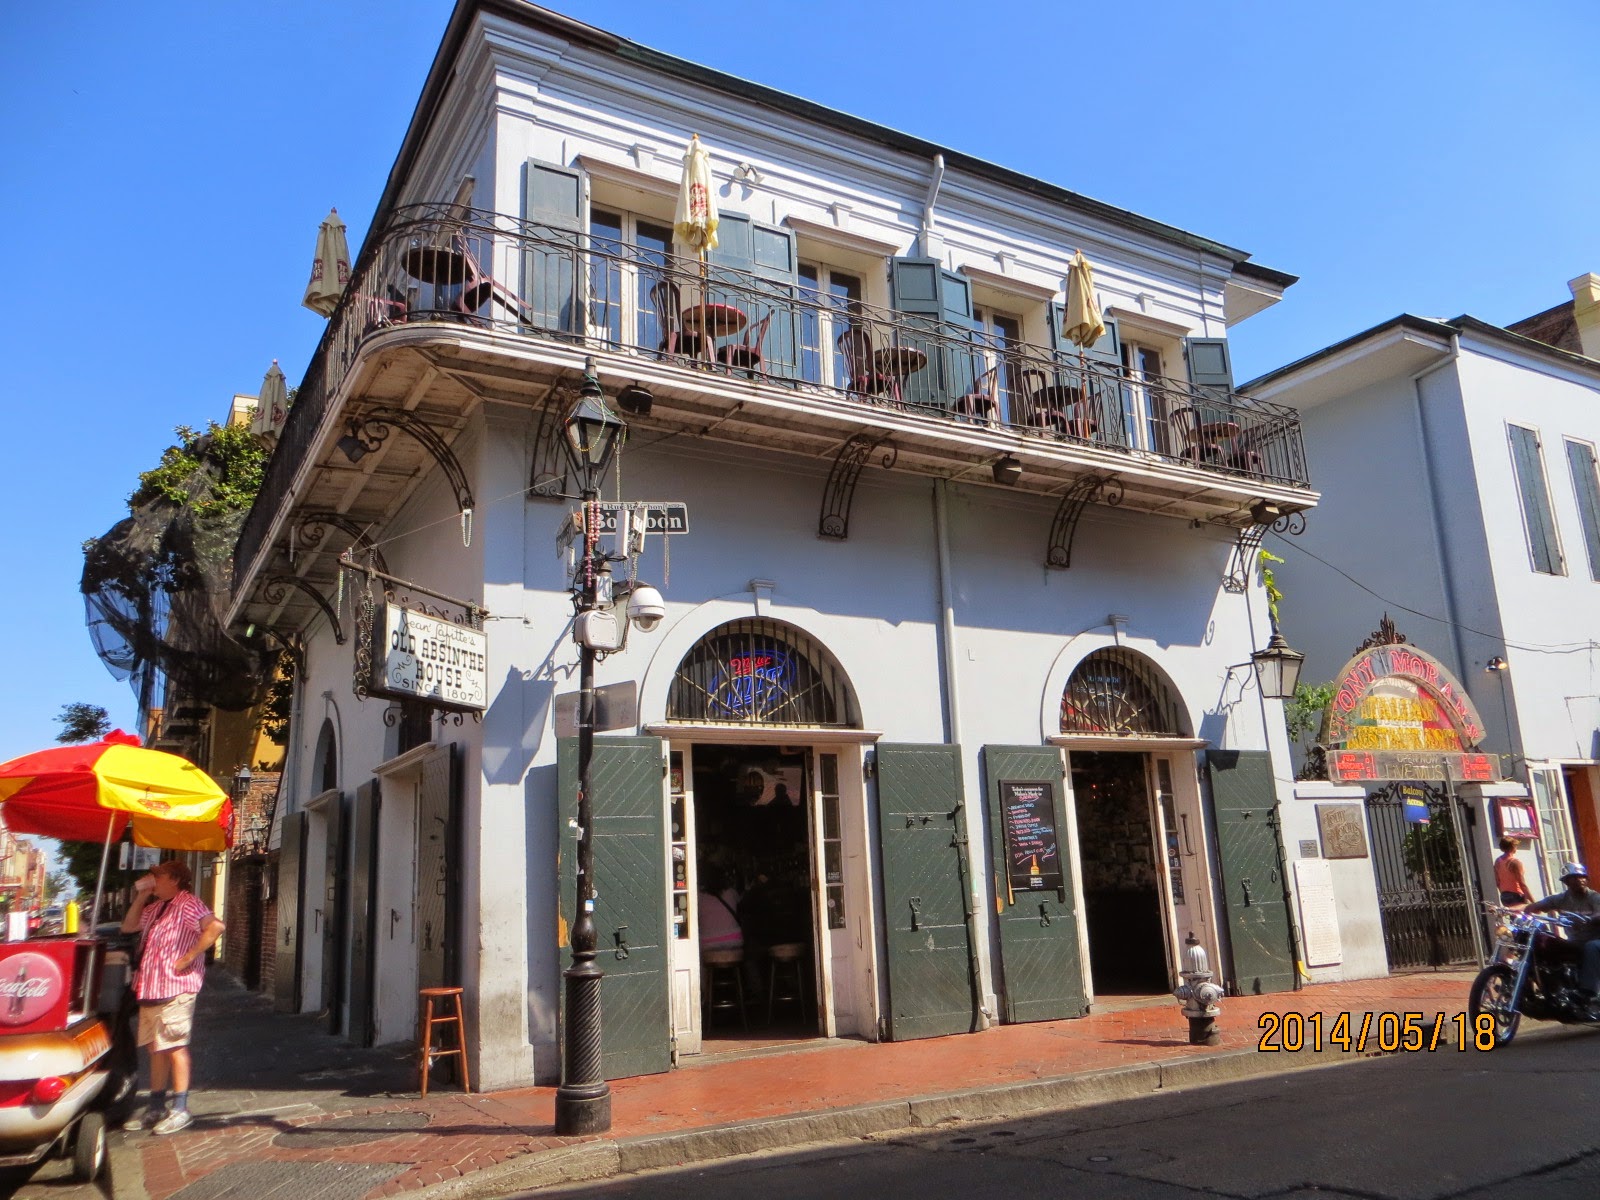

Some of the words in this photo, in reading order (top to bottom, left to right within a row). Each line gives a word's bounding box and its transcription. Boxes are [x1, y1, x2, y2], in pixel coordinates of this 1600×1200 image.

[430, 623, 476, 647] Lafitte's
[392, 630, 416, 655] OLD
[421, 638, 484, 672] ABSINTHE
[415, 659, 462, 689] HOUSE
[402, 678, 439, 694] SINCE
[446, 688, 474, 702] 1807
